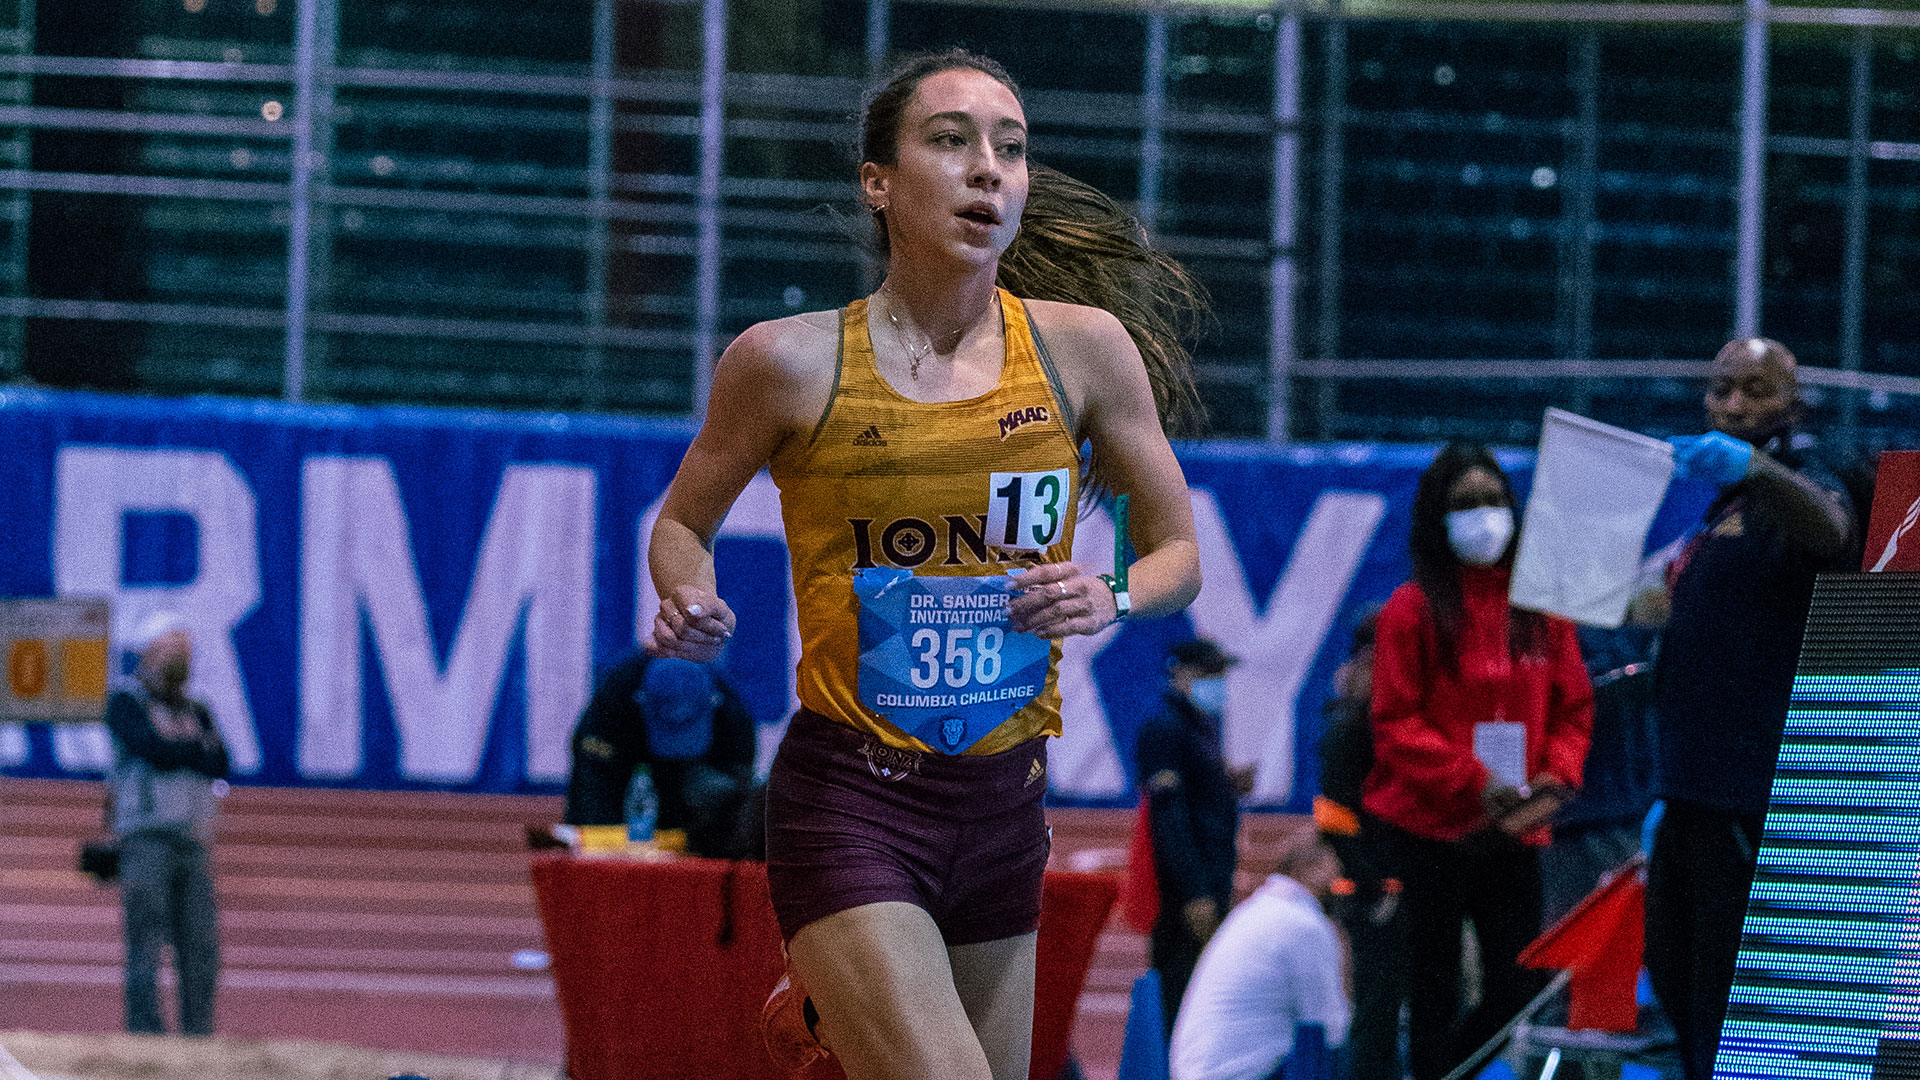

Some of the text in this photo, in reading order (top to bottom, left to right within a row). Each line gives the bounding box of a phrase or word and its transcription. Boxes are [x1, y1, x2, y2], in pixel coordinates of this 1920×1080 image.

[998, 406, 1050, 442] MAAC
[996, 474, 1061, 546] 13
[847, 514, 1045, 569] ION
[0, 443, 1387, 808] RMOY
[910, 593, 1011, 609] DR. SANDER
[910, 626, 1004, 690] 358
[876, 685, 1035, 707] COLUMBIA CHALLENGE
